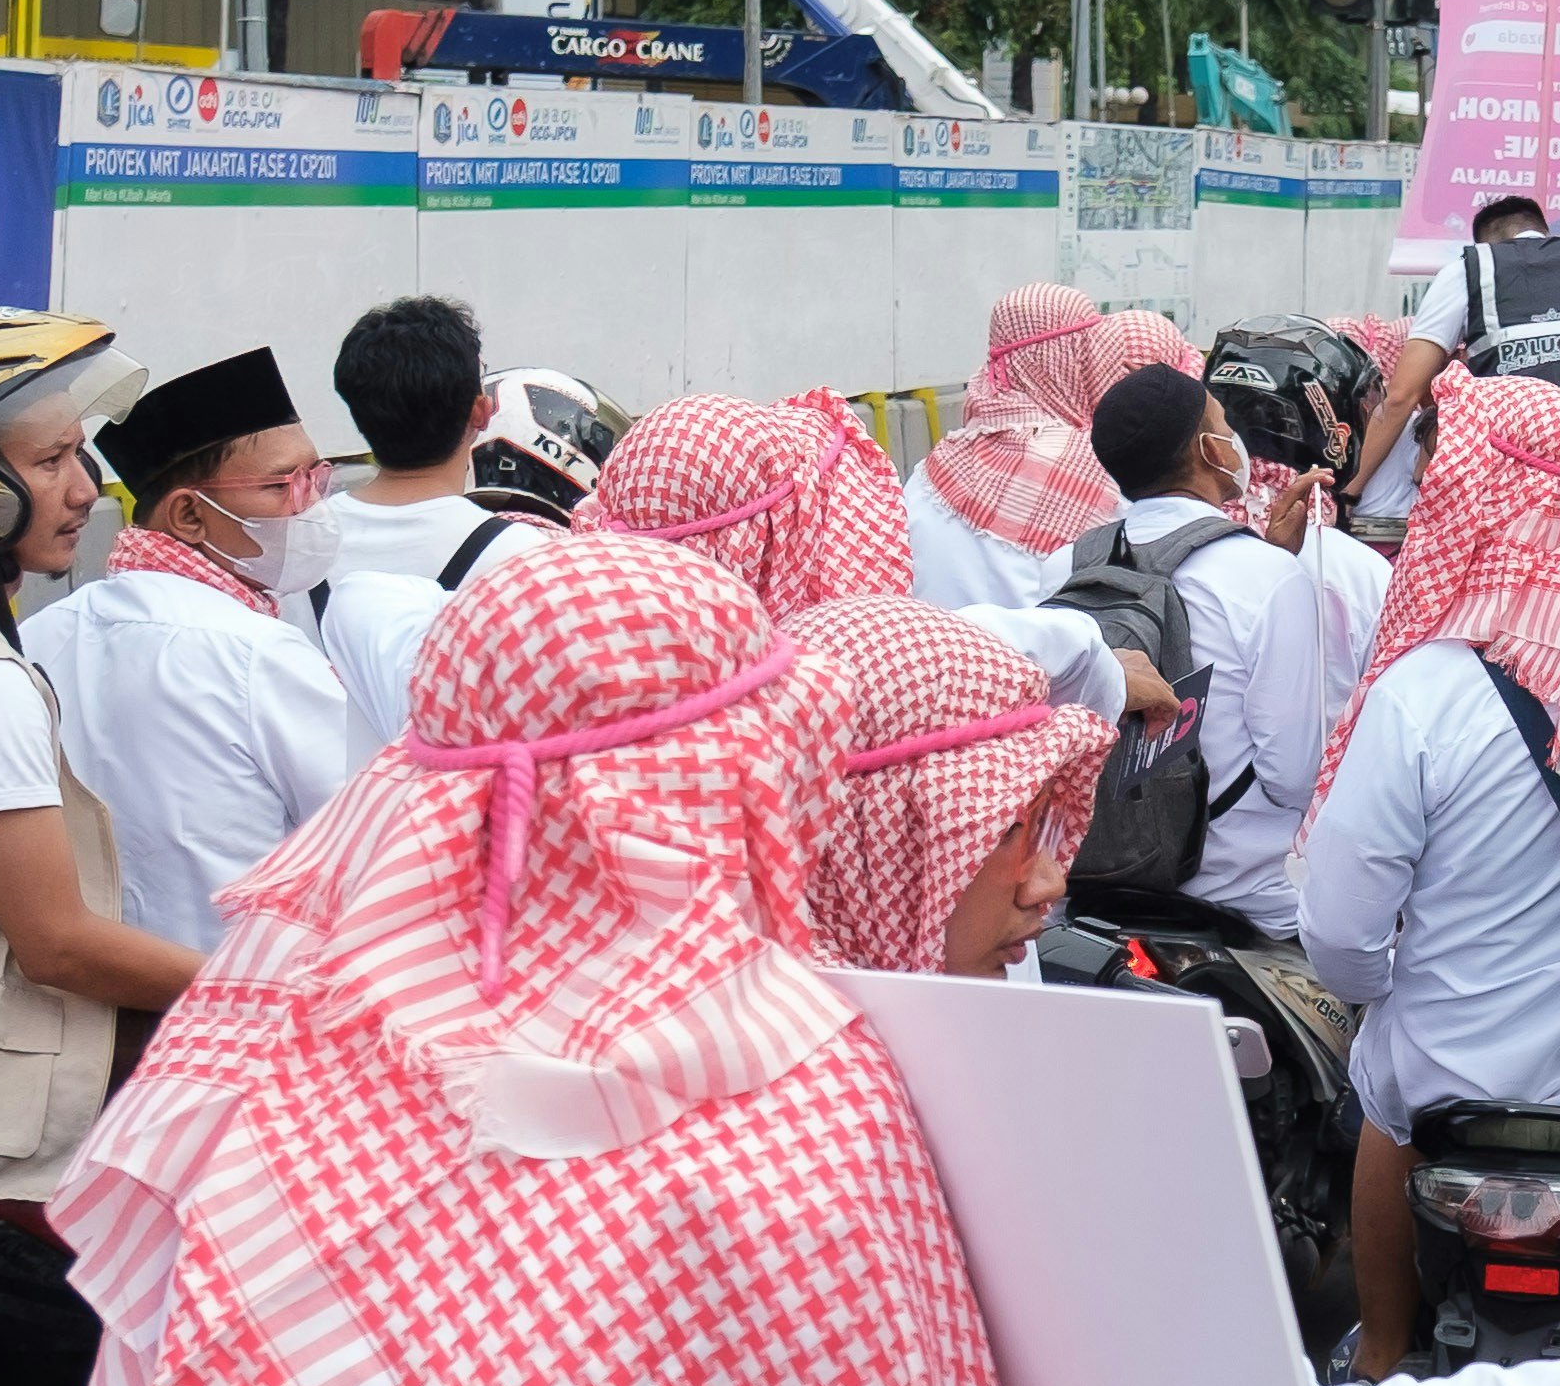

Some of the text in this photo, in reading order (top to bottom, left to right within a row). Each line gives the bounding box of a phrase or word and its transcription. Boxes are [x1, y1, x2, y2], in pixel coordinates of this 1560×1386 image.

[550, 36, 705, 63] CARGO CRANE
[84, 147, 337, 181] PROYEK MRT JAKARTA FASE 2 CP201
